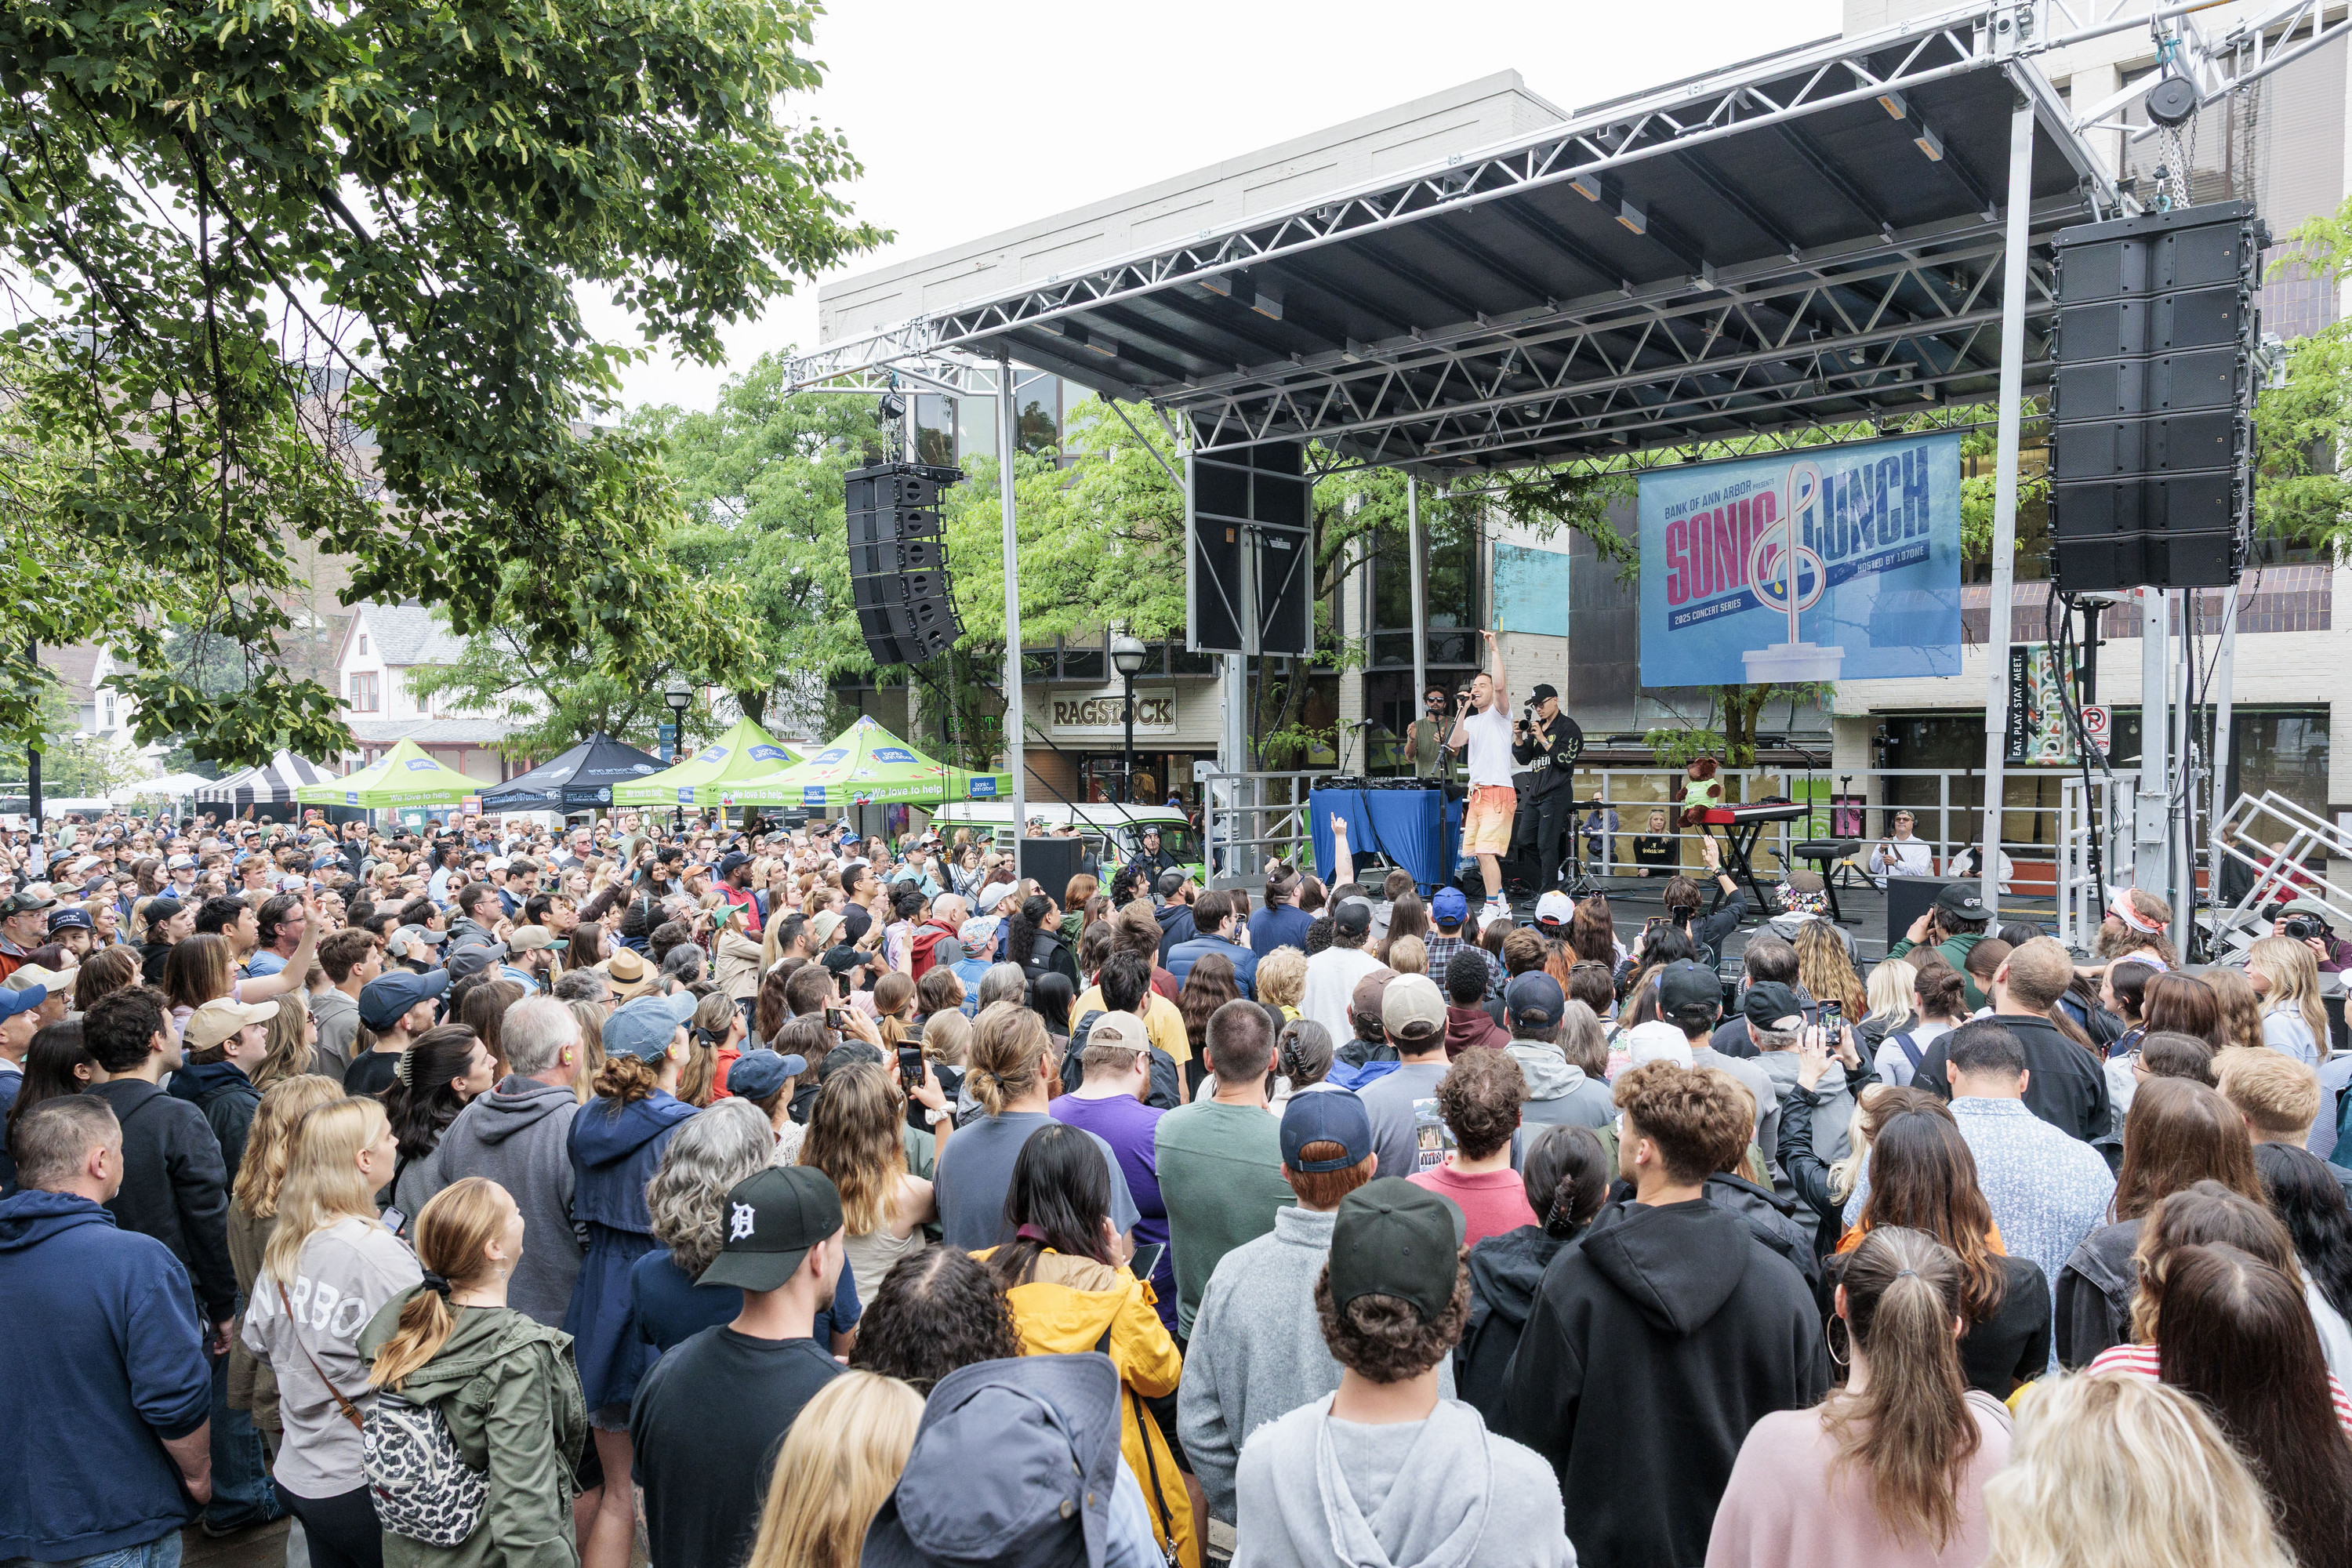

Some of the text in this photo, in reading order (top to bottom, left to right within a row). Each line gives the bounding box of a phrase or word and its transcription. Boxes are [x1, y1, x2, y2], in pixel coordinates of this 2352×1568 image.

[1665, 477, 1774, 519] BANK OF ANN ARBOR PRESENTS
[1665, 445, 1930, 606] SONIC LUNCH
[1857, 557, 1883, 573] HOSTED
[1886, 554, 1895, 564] BY
[1675, 598, 1741, 625] 2025 CONCERT SERIES
[2013, 655, 2022, 757] EAT. PLAY. STAY. MEET.
[390, 793, 405, 802] We
[406, 793, 422, 801] love
[433, 791, 452, 800] help.
[733, 789, 784, 800] We love to help.
[872, 788, 886, 797] We
[888, 787, 908, 796] love
[911, 786, 920, 795] to
[729, 1201, 756, 1243] D
[280, 1275, 374, 1340] RBO
